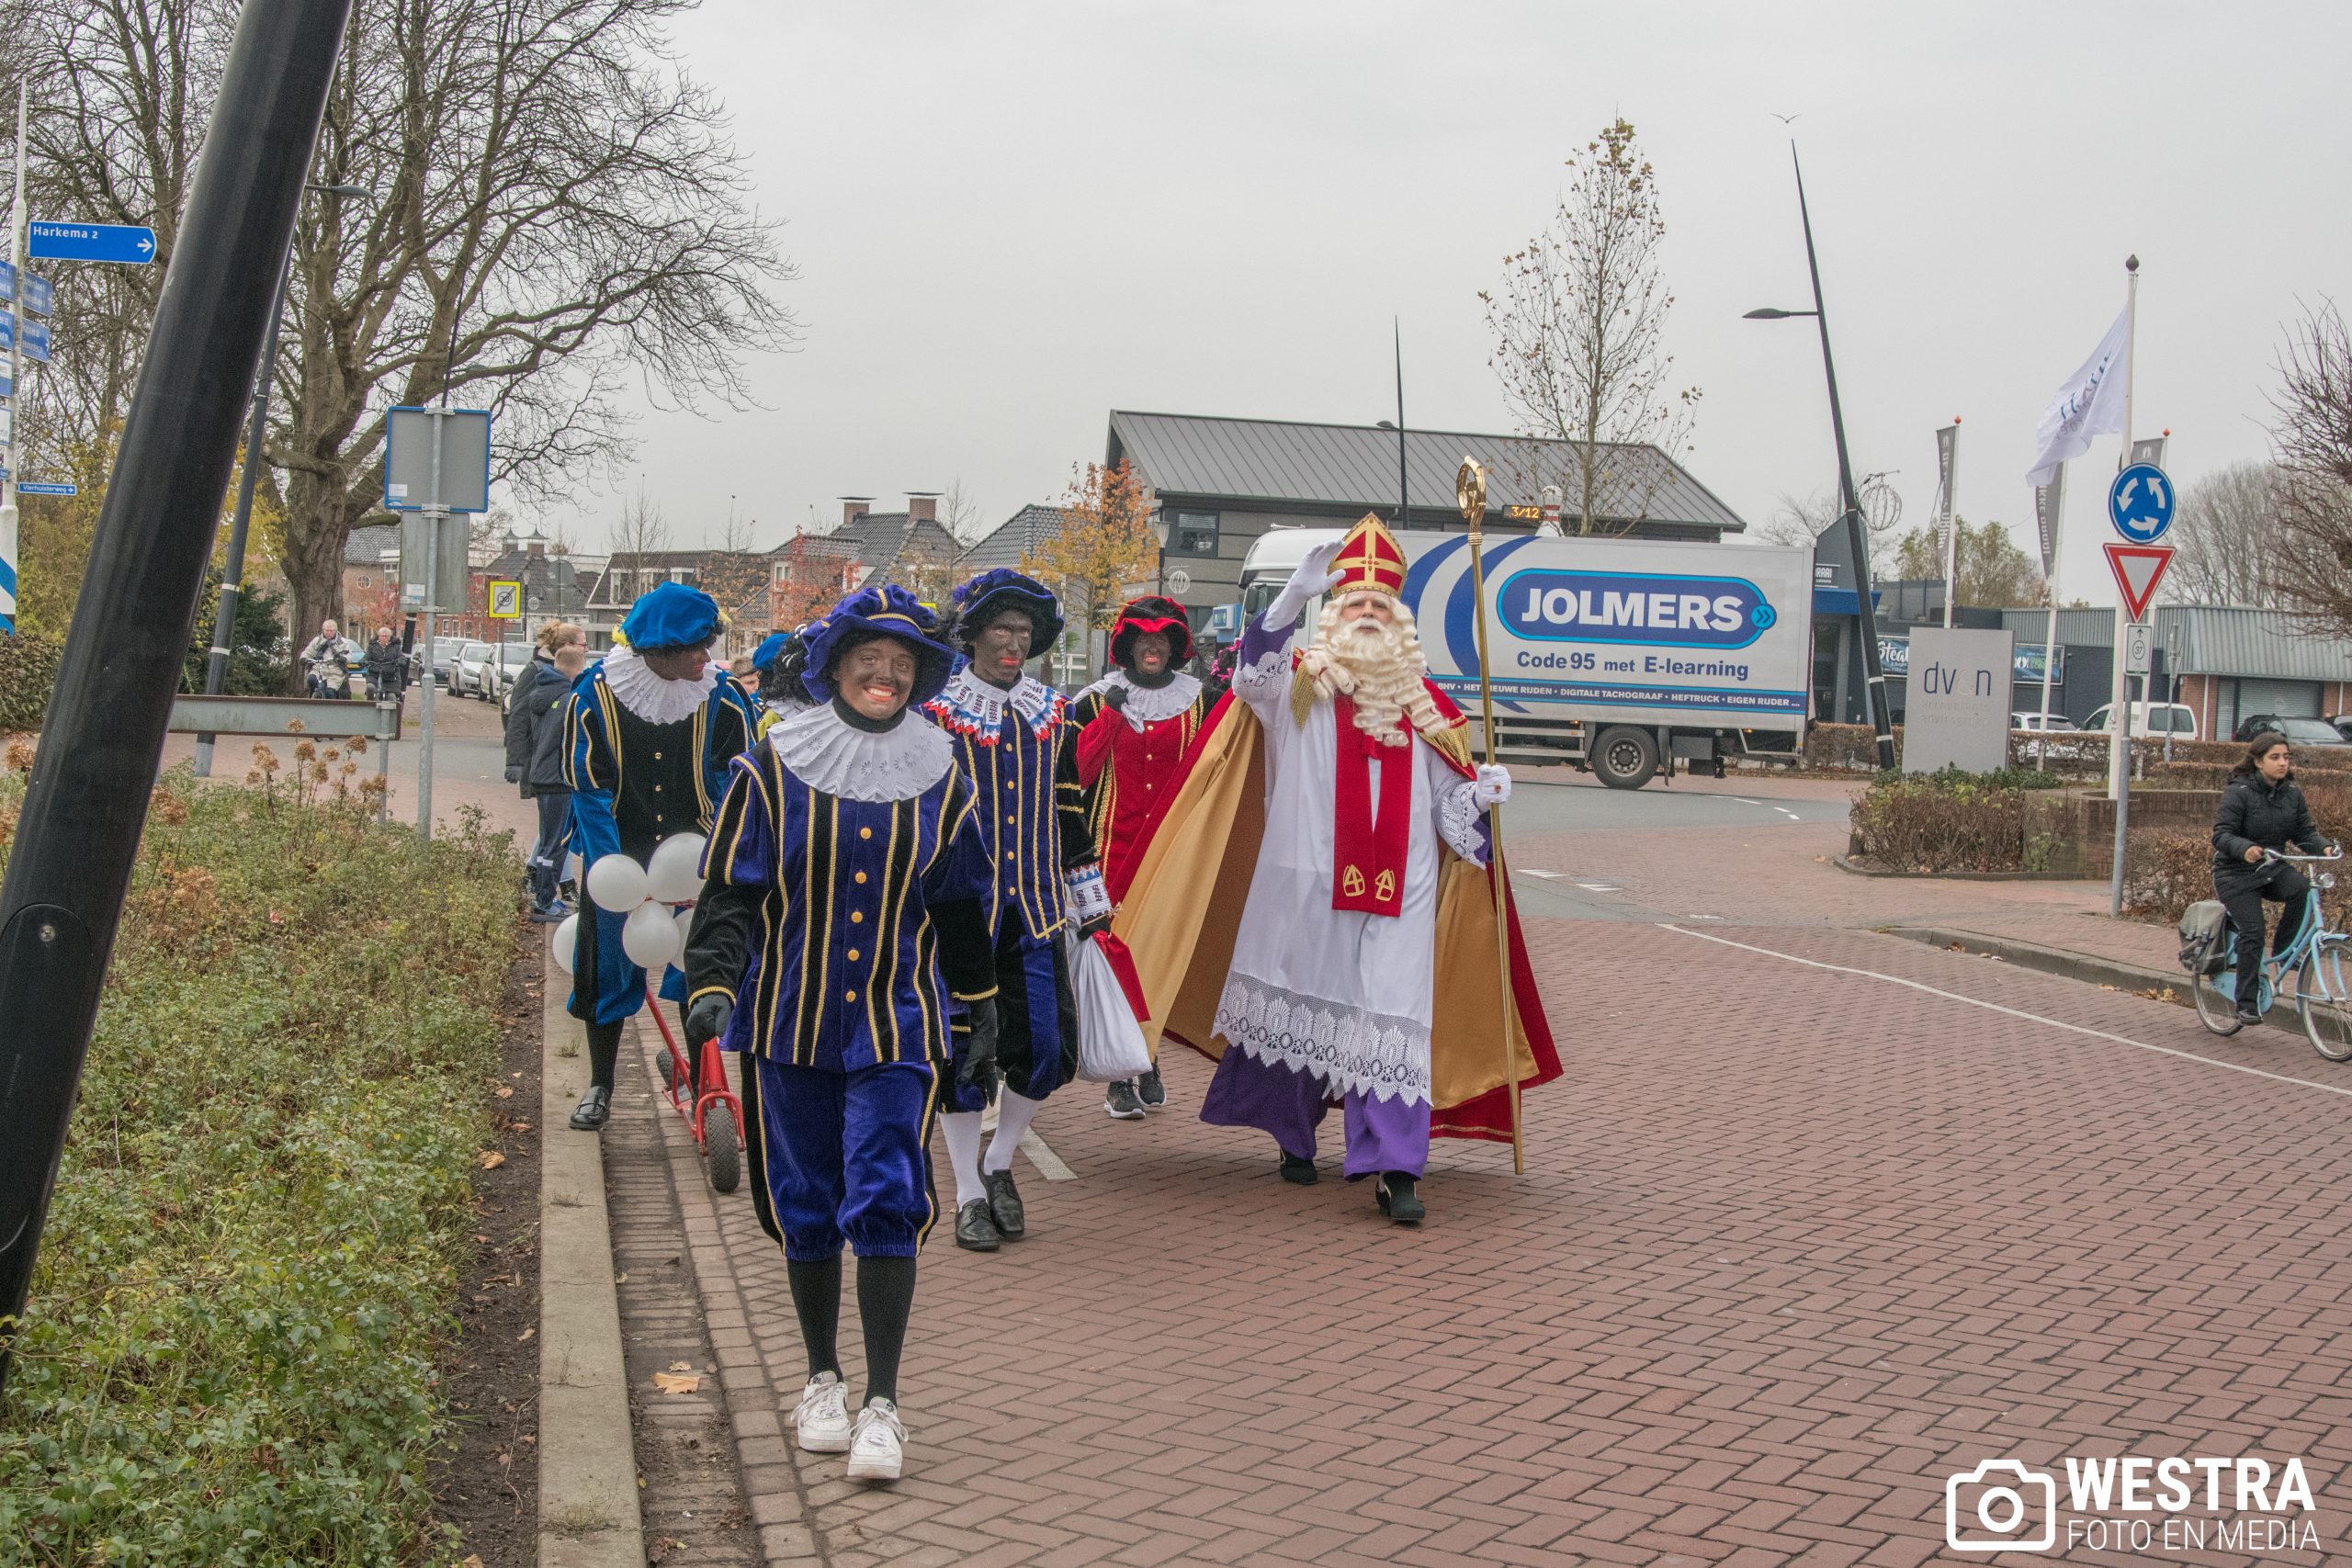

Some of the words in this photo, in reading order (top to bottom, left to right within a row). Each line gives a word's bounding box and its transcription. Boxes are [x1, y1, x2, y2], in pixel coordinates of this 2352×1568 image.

[33, 226, 88, 239] Harkema
[92, 231, 98, 239] 2
[22, 484, 67, 493] Vierhuisterweg
[2038, 485, 2048, 513] IKKE
[1511, 506, 1539, 518] 3/12
[1521, 588, 1743, 632] JOLMERS
[2134, 646, 2143, 655] 37
[1517, 651, 1567, 669] Code
[1570, 652, 1596, 671] 95
[1603, 660, 1635, 672] met
[1644, 656, 1749, 682] E-learning
[1437, 682, 1456, 691] BHV
[1464, 683, 1482, 692] HET
[1488, 684, 1519, 694] IEUWE
[1521, 686, 1552, 695] RIJDEN
[1560, 689, 1600, 698] DIGITALE
[1601, 690, 1663, 701] TACHOGRAAF
[1670, 694, 1720, 704] HEFTRUCK
[1726, 695, 1756, 705] EIGEN
[1757, 697, 1790, 707] RIJDER
